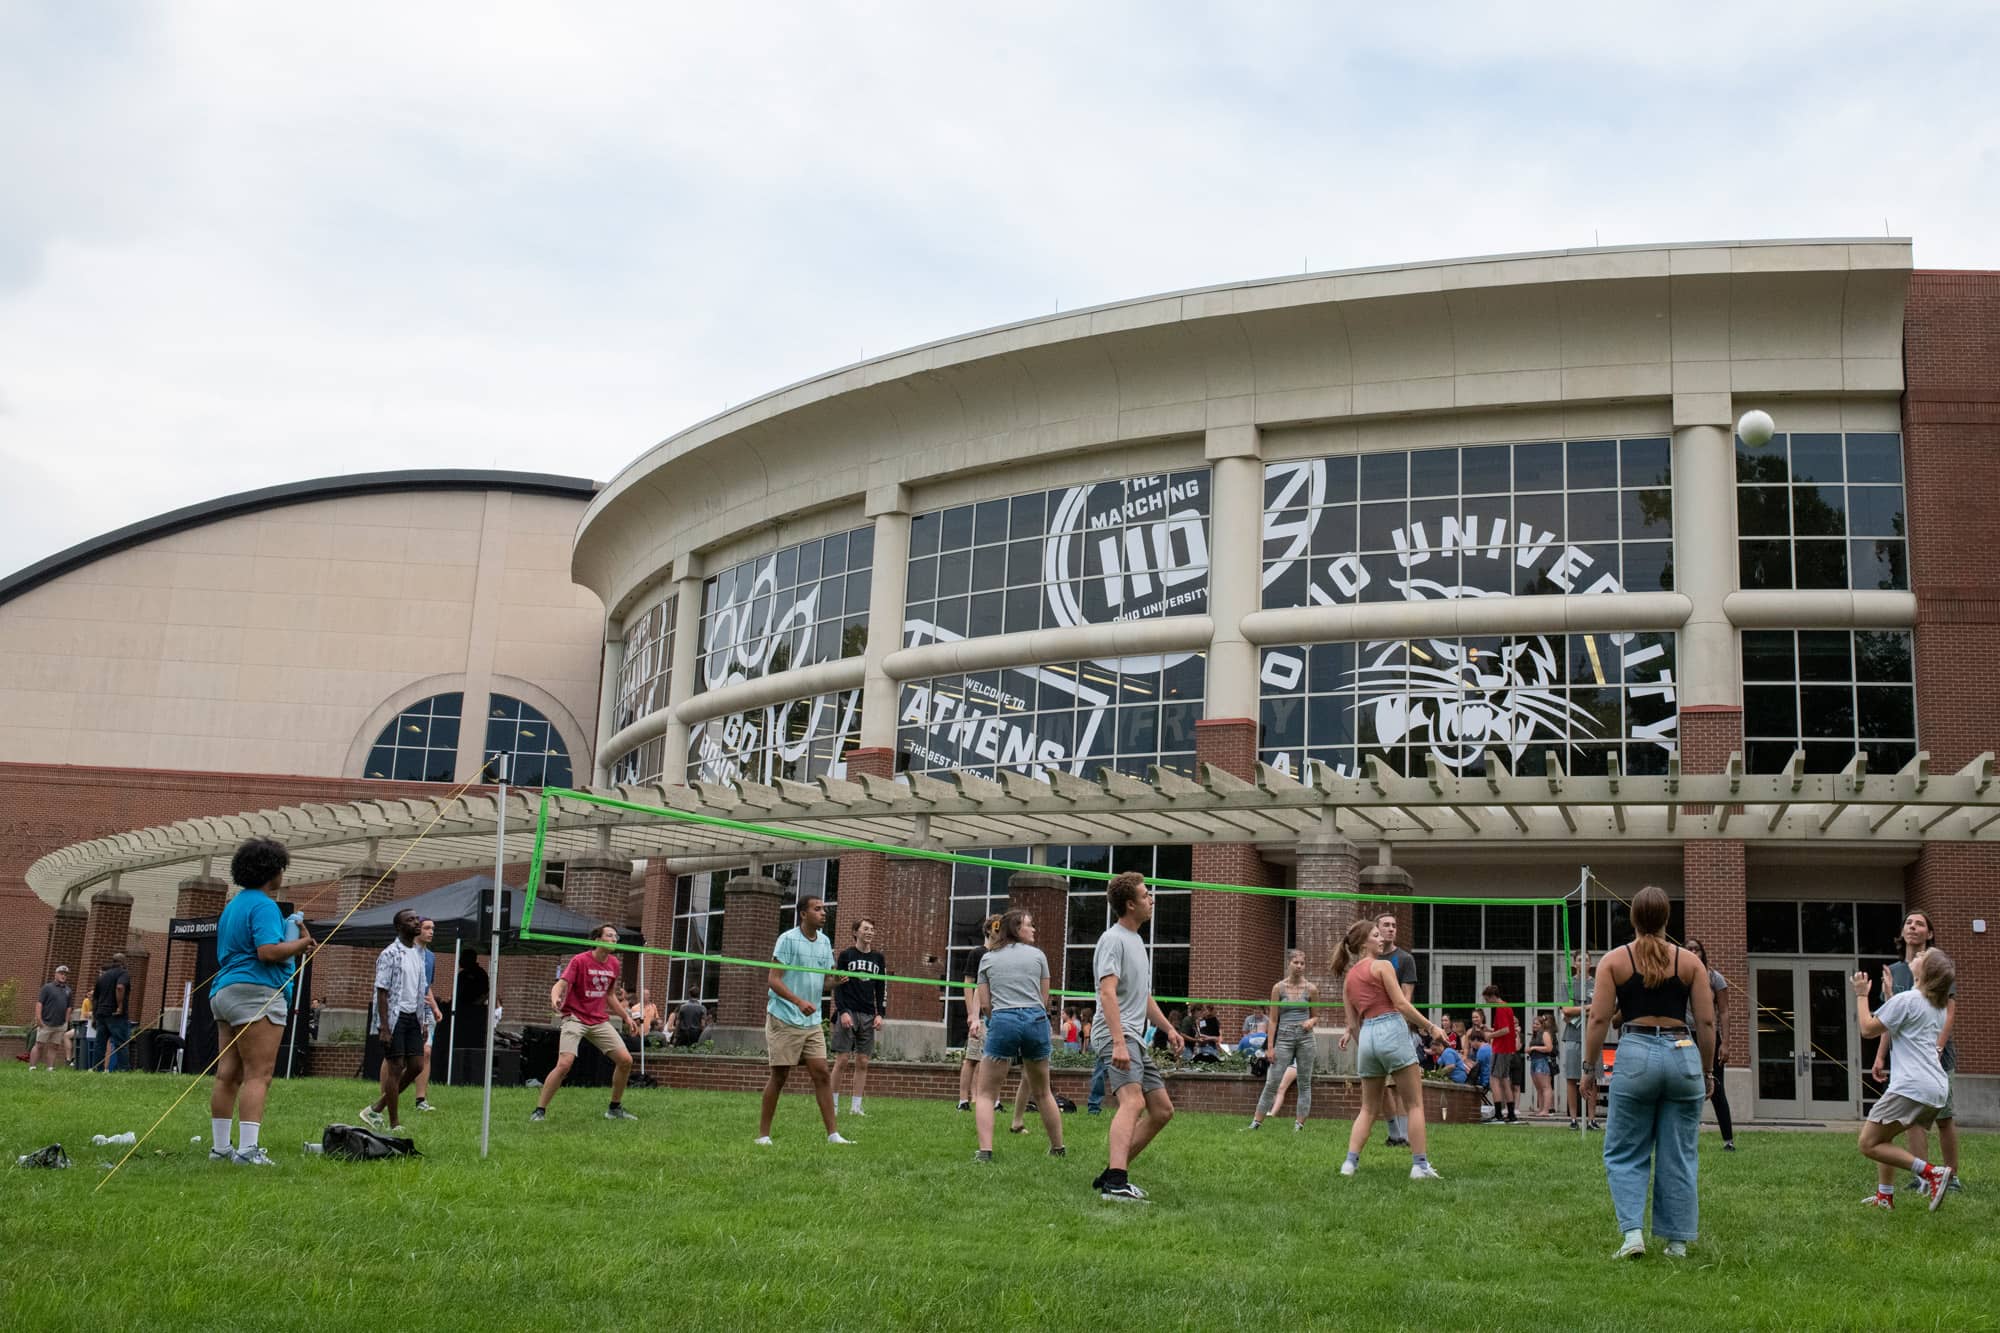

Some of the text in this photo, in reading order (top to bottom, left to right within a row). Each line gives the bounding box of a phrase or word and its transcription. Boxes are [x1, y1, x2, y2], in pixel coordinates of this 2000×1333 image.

[1090, 479, 1200, 529] MARCHING
[1099, 508, 1209, 608] 110
[1142, 586, 1208, 616] UNIVERSITY
[965, 677, 1026, 710] WELCOME TO
[901, 686, 1065, 785] ATHENS
[910, 742, 926, 758] THE
[927, 749, 951, 767] BEST
[174, 924, 194, 933] PHOTO
[848, 960, 880, 975] OHIO
